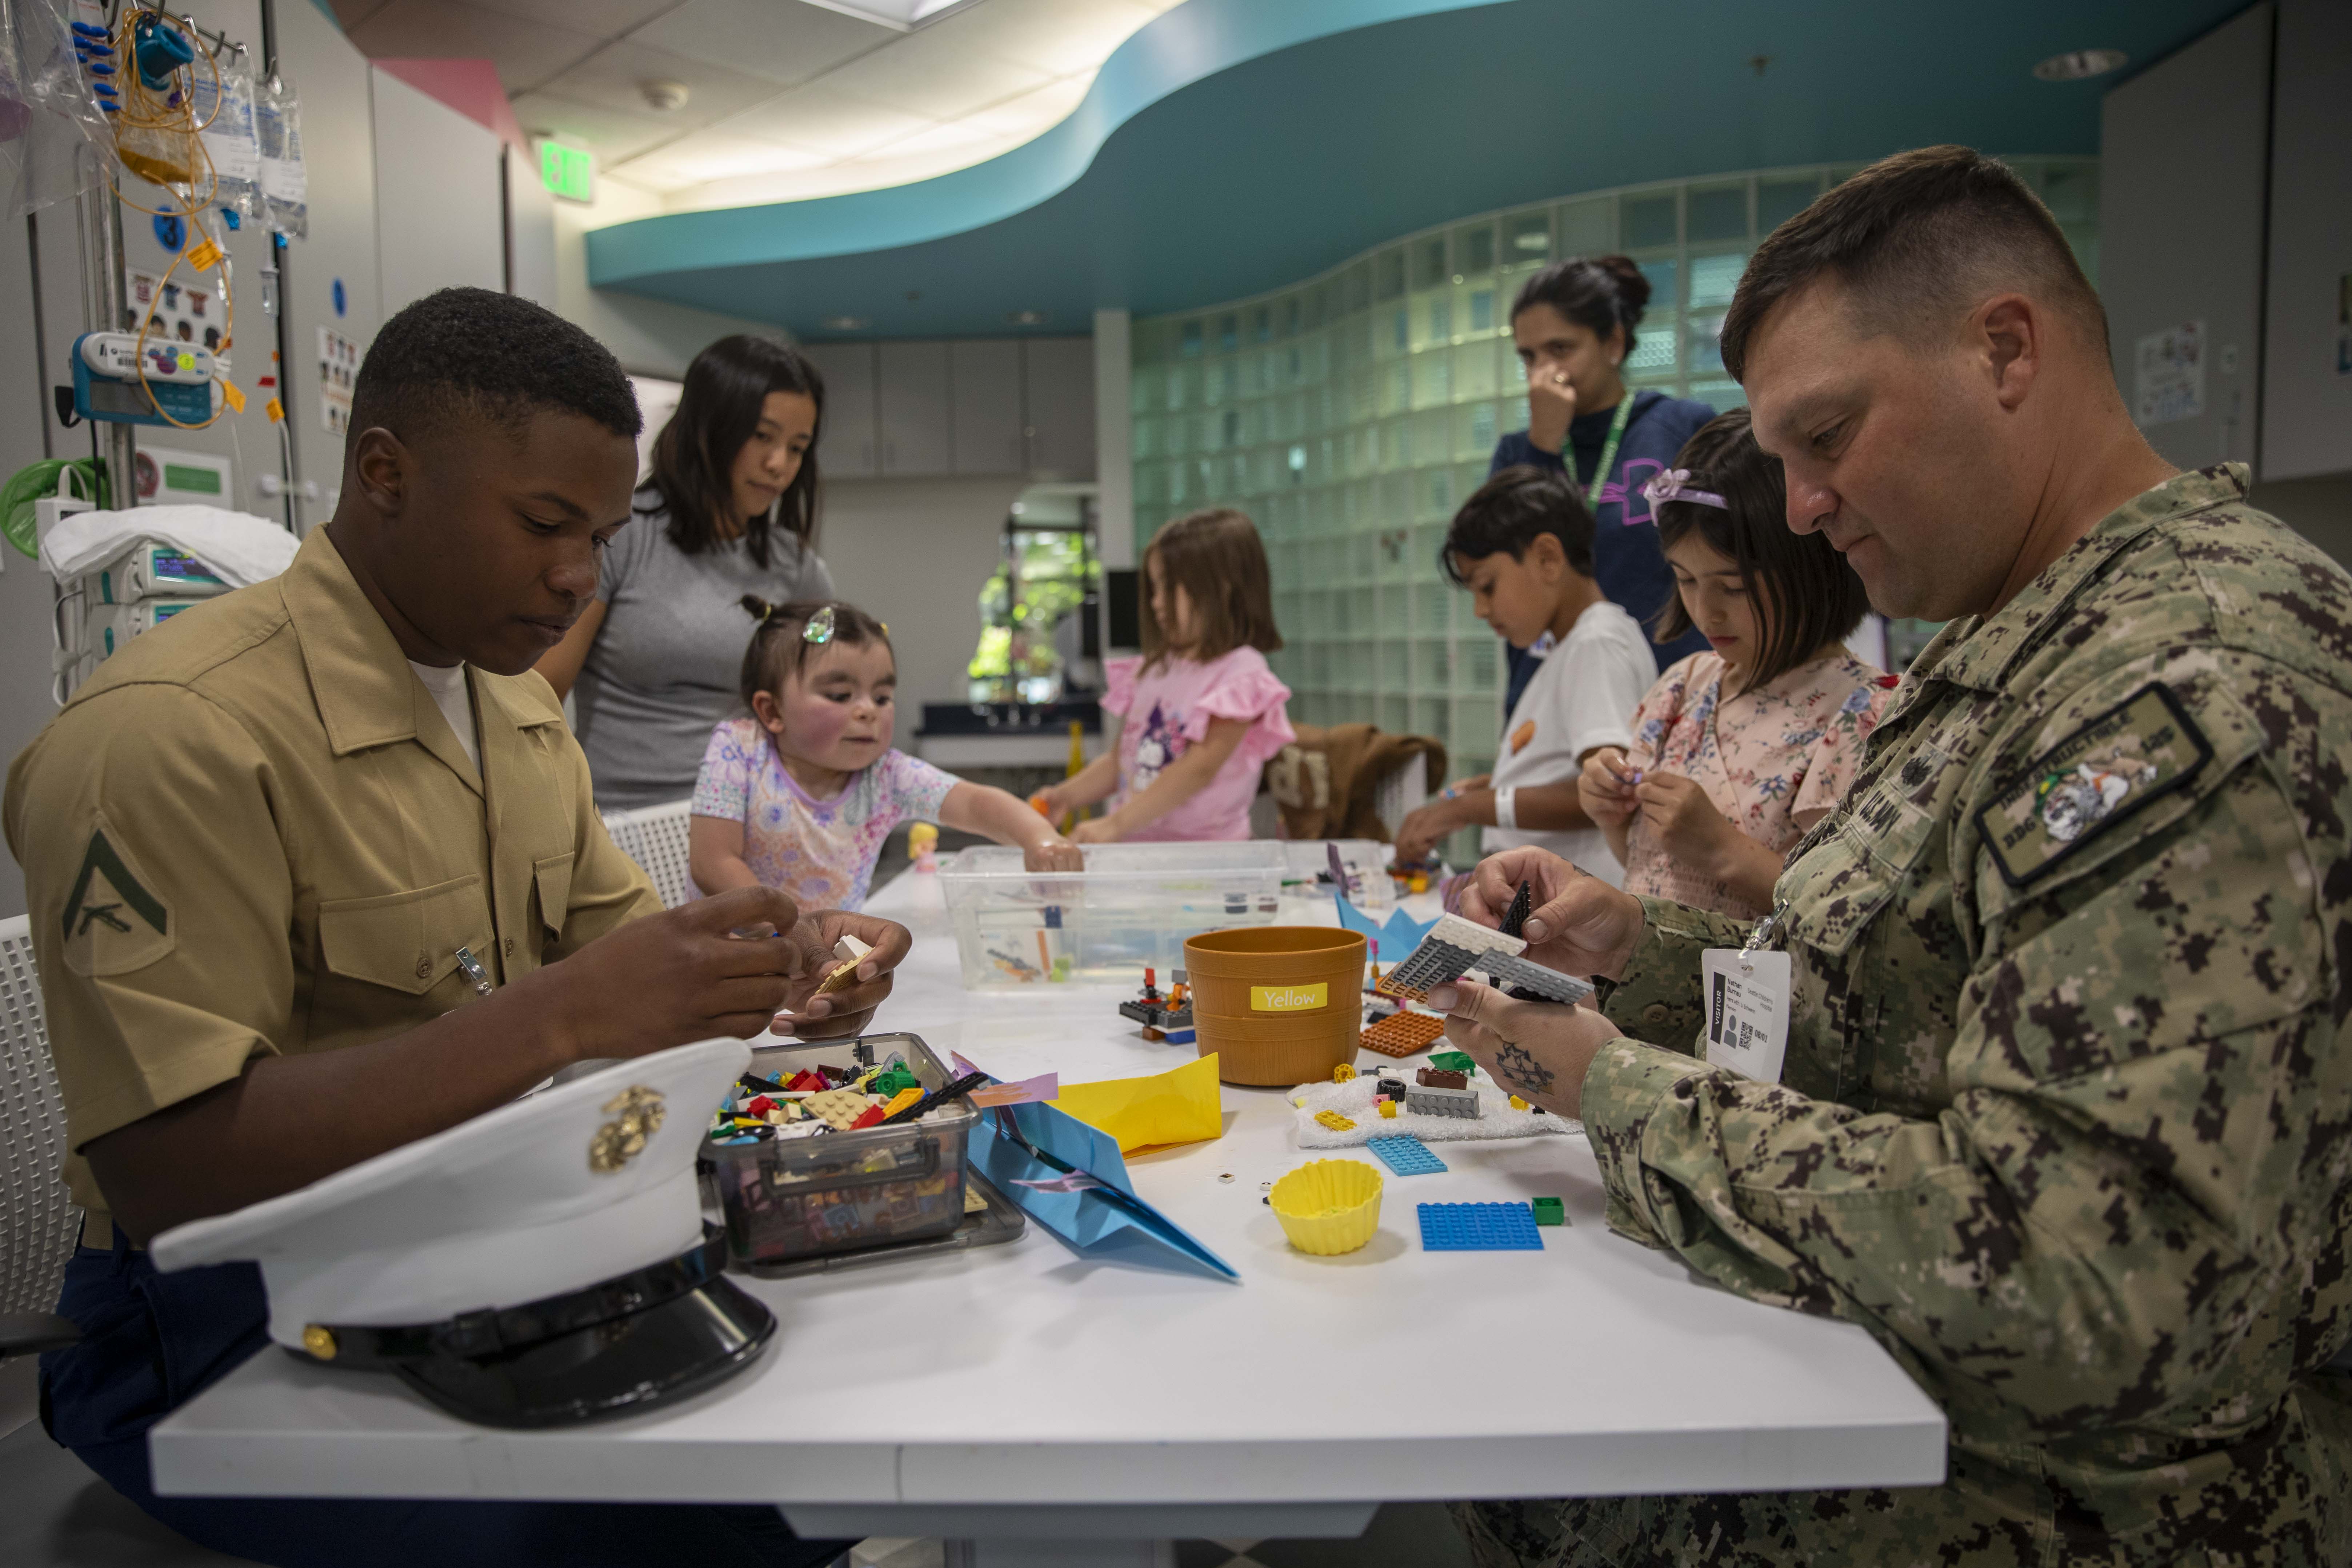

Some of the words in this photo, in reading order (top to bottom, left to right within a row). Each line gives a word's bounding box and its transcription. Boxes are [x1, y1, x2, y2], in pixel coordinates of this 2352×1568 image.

[541, 140, 591, 201] EXIT
[2003, 816, 2036, 850] DDG
[1727, 978, 1742, 989] Nathan
[1264, 990, 1315, 1007] Yellow
[1747, 988, 1758, 998] Seattle
[1760, 1001, 1773, 1012] Hospital
[1755, 1029, 1768, 1043] 08/01
